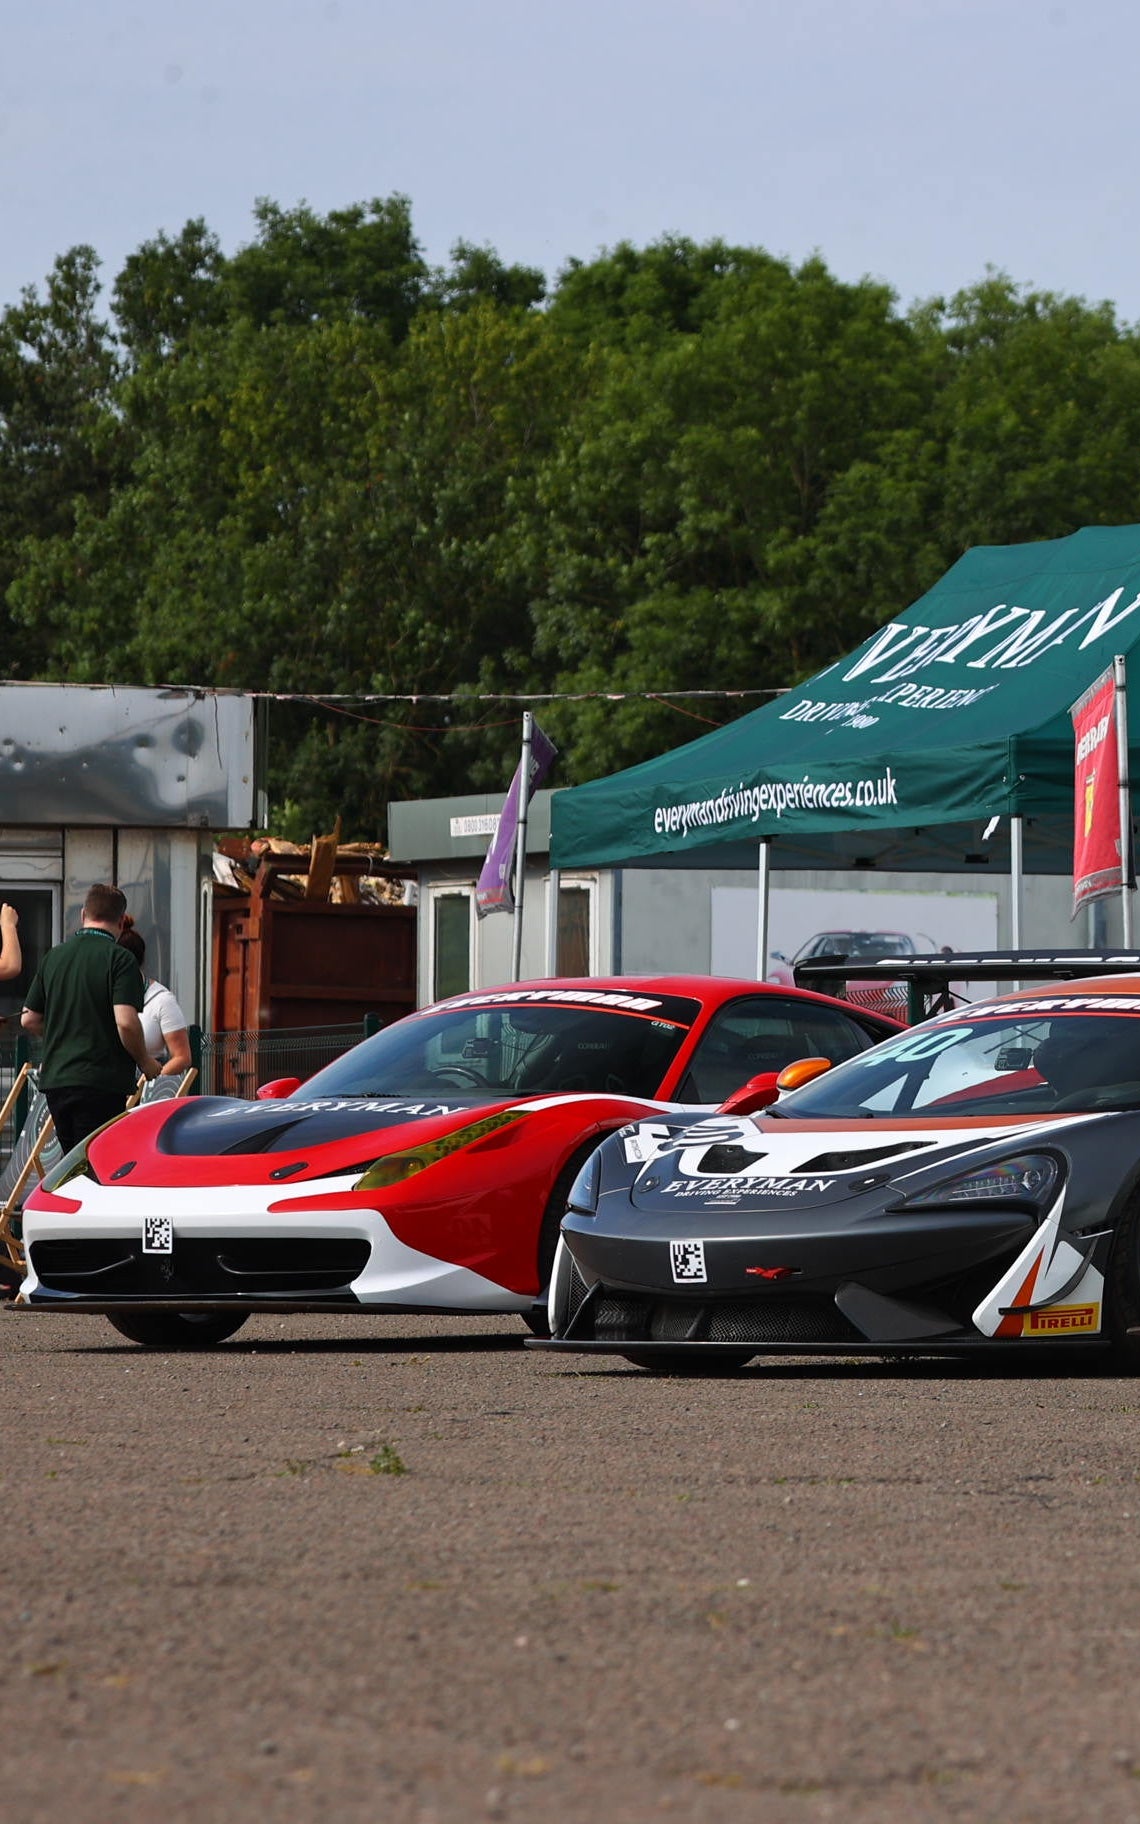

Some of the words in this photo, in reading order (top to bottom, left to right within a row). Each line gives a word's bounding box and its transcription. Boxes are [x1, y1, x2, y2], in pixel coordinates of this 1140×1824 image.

[654, 767, 898, 837] everymandrivingexperiences.co.uk
[421, 990, 663, 1016] EVERYMAN
[207, 1101, 470, 1117] EVERYMAN
[660, 1177, 838, 1194] EVERYMAN
[674, 1190, 720, 1198] DRIVING
[722, 1188, 799, 1197] EXPERIENCES
[1030, 1307, 1095, 1330] PIRELLI
